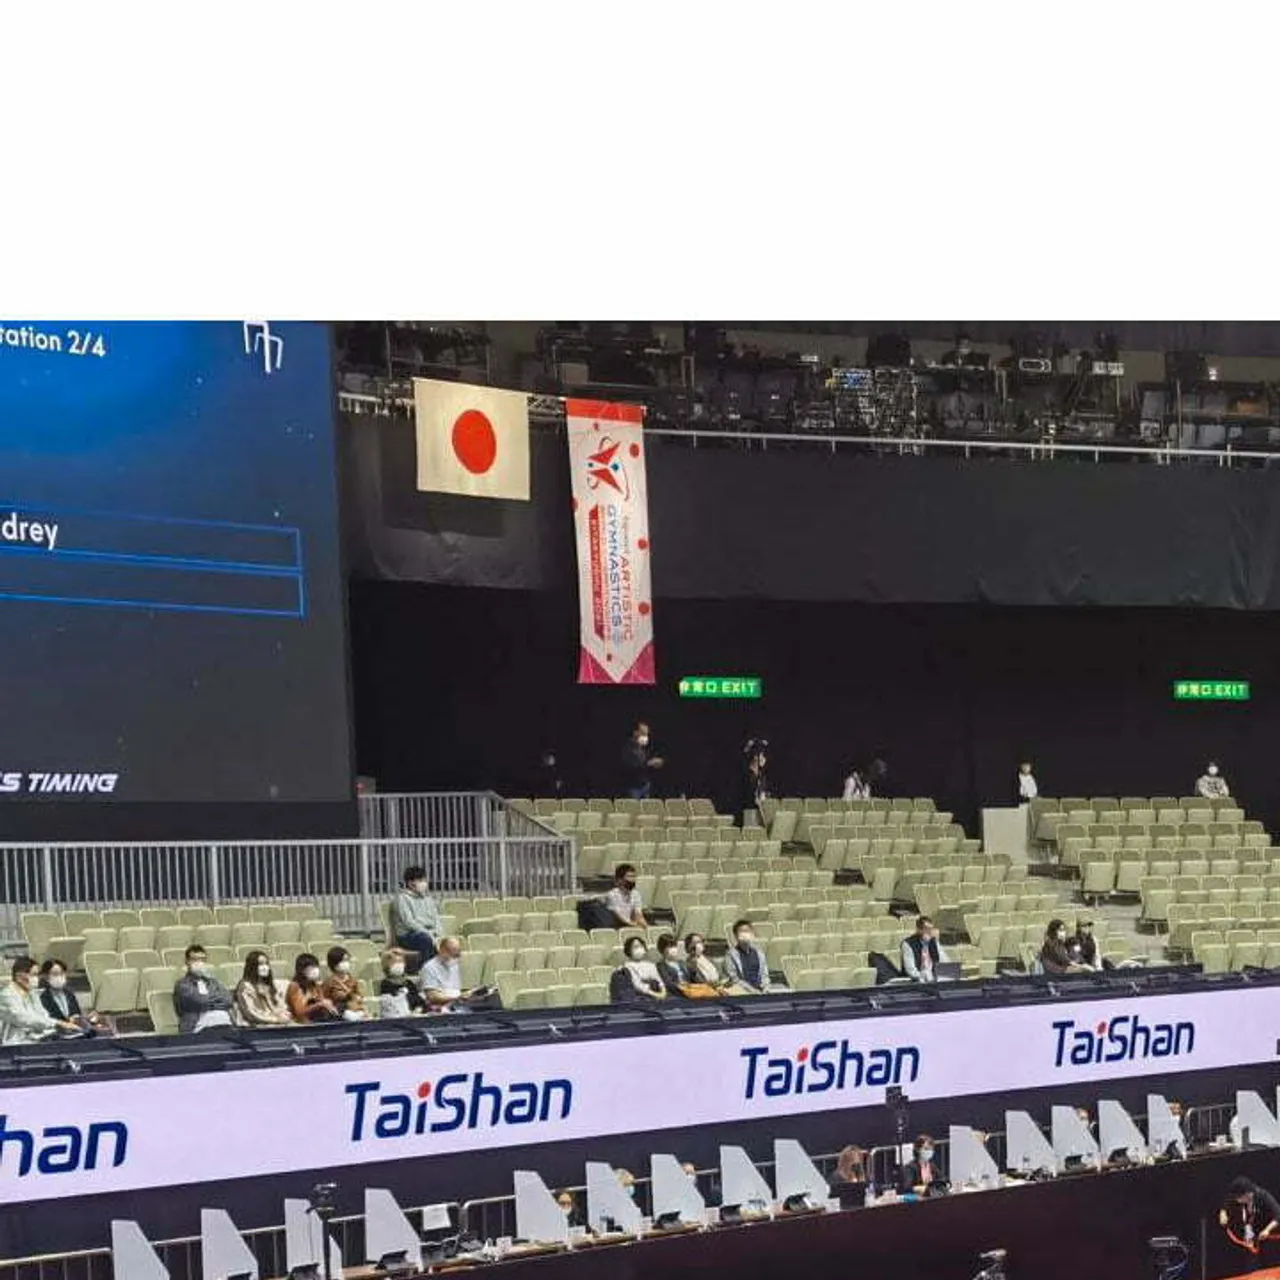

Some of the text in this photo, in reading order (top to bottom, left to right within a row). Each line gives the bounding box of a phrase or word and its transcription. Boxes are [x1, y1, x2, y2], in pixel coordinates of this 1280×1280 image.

[67, 330, 106, 357] 2/4
[1, 512, 58, 551] drey
[721, 680, 756, 694] EXIT
[1215, 684, 1247, 697] EXIT
[0, 771, 118, 792] S TIMING
[1052, 1015, 1195, 1067] TaiShan
[740, 1040, 921, 1098] TaiShan
[345, 1072, 573, 1141] TaiShan
